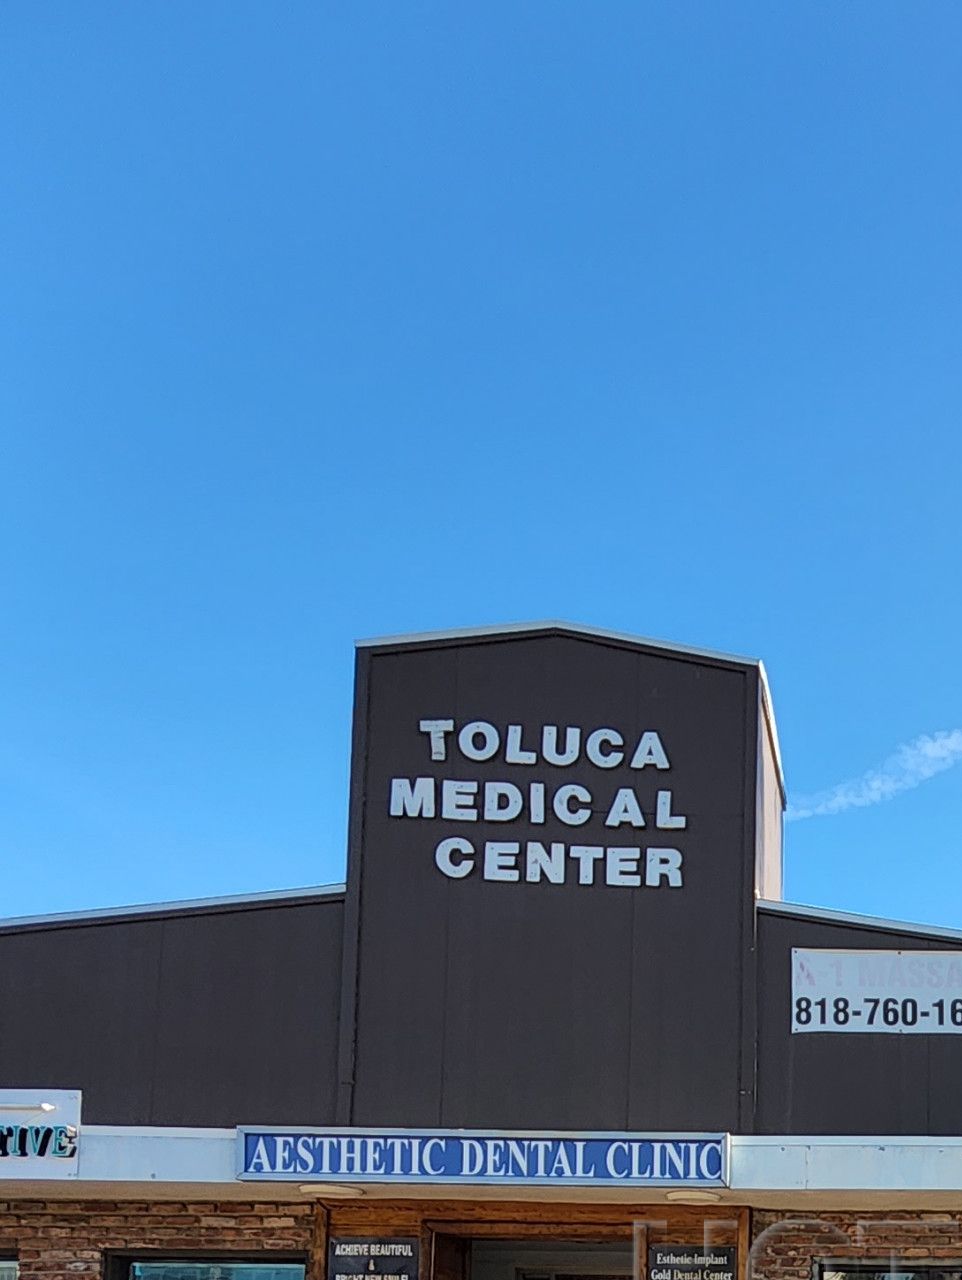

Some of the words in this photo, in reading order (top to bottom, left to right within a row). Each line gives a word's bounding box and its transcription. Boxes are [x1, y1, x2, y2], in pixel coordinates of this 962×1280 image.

[419, 719, 671, 770] TOLUCA
[389, 777, 687, 830] MEDICAL
[434, 836, 684, 888] CENTER
[247, 1136, 446, 1176] AESTHETIC
[459, 1139, 596, 1178] DENTAL
[605, 1141, 722, 1180] CLINIC
[335, 1244, 369, 1256] ACHIEVE
[370, 1244, 413, 1257] BEAUTIFUL
[656, 1252, 692, 1265] Esthetic
[694, 1253, 728, 1267] Implant
[651, 1269, 672, 1280] Gold
[673, 1269, 702, 1280] Dental
[703, 1269, 733, 1280] Center
